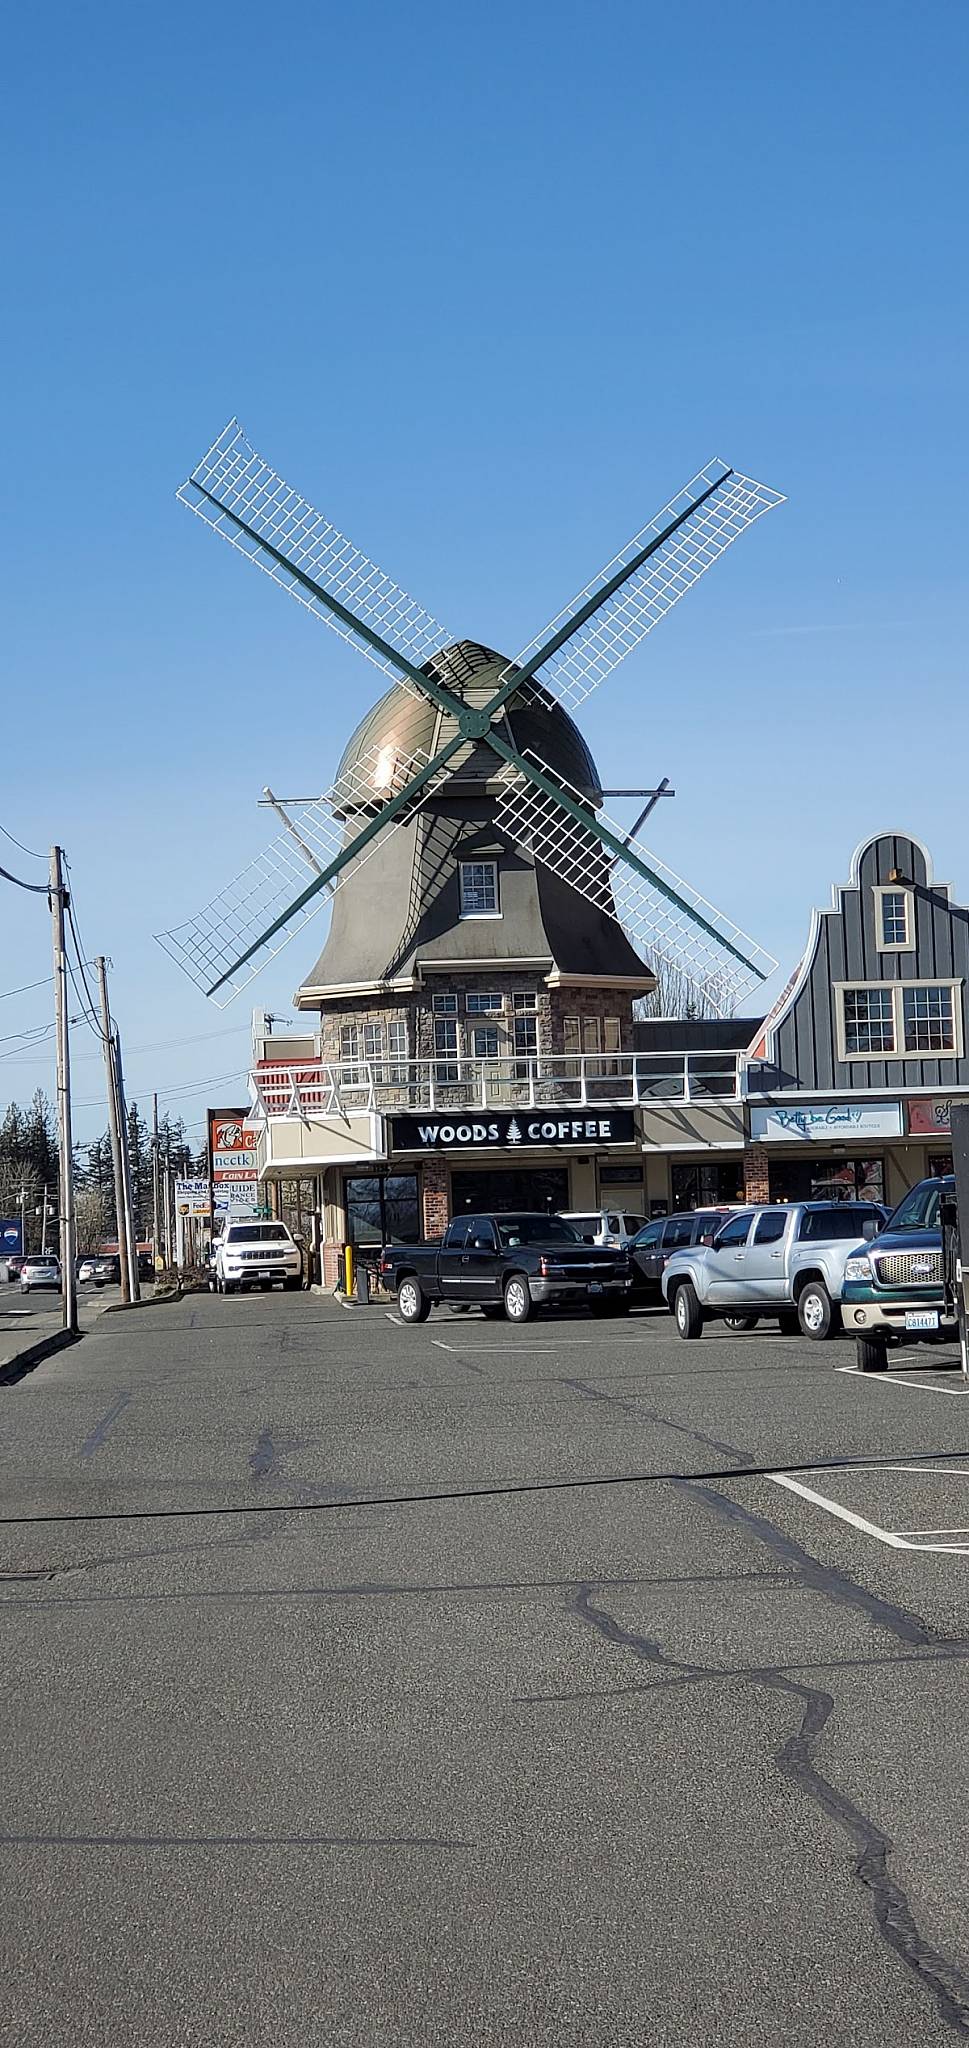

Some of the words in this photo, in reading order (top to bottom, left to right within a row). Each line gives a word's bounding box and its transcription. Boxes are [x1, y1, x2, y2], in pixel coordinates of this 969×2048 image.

[776, 1110, 807, 1132] Betty
[826, 1107, 853, 1124] Good
[418, 1124, 500, 1143] WOODS
[527, 1120, 612, 1139] COFFEE
[177, 1182, 193, 1191] The
